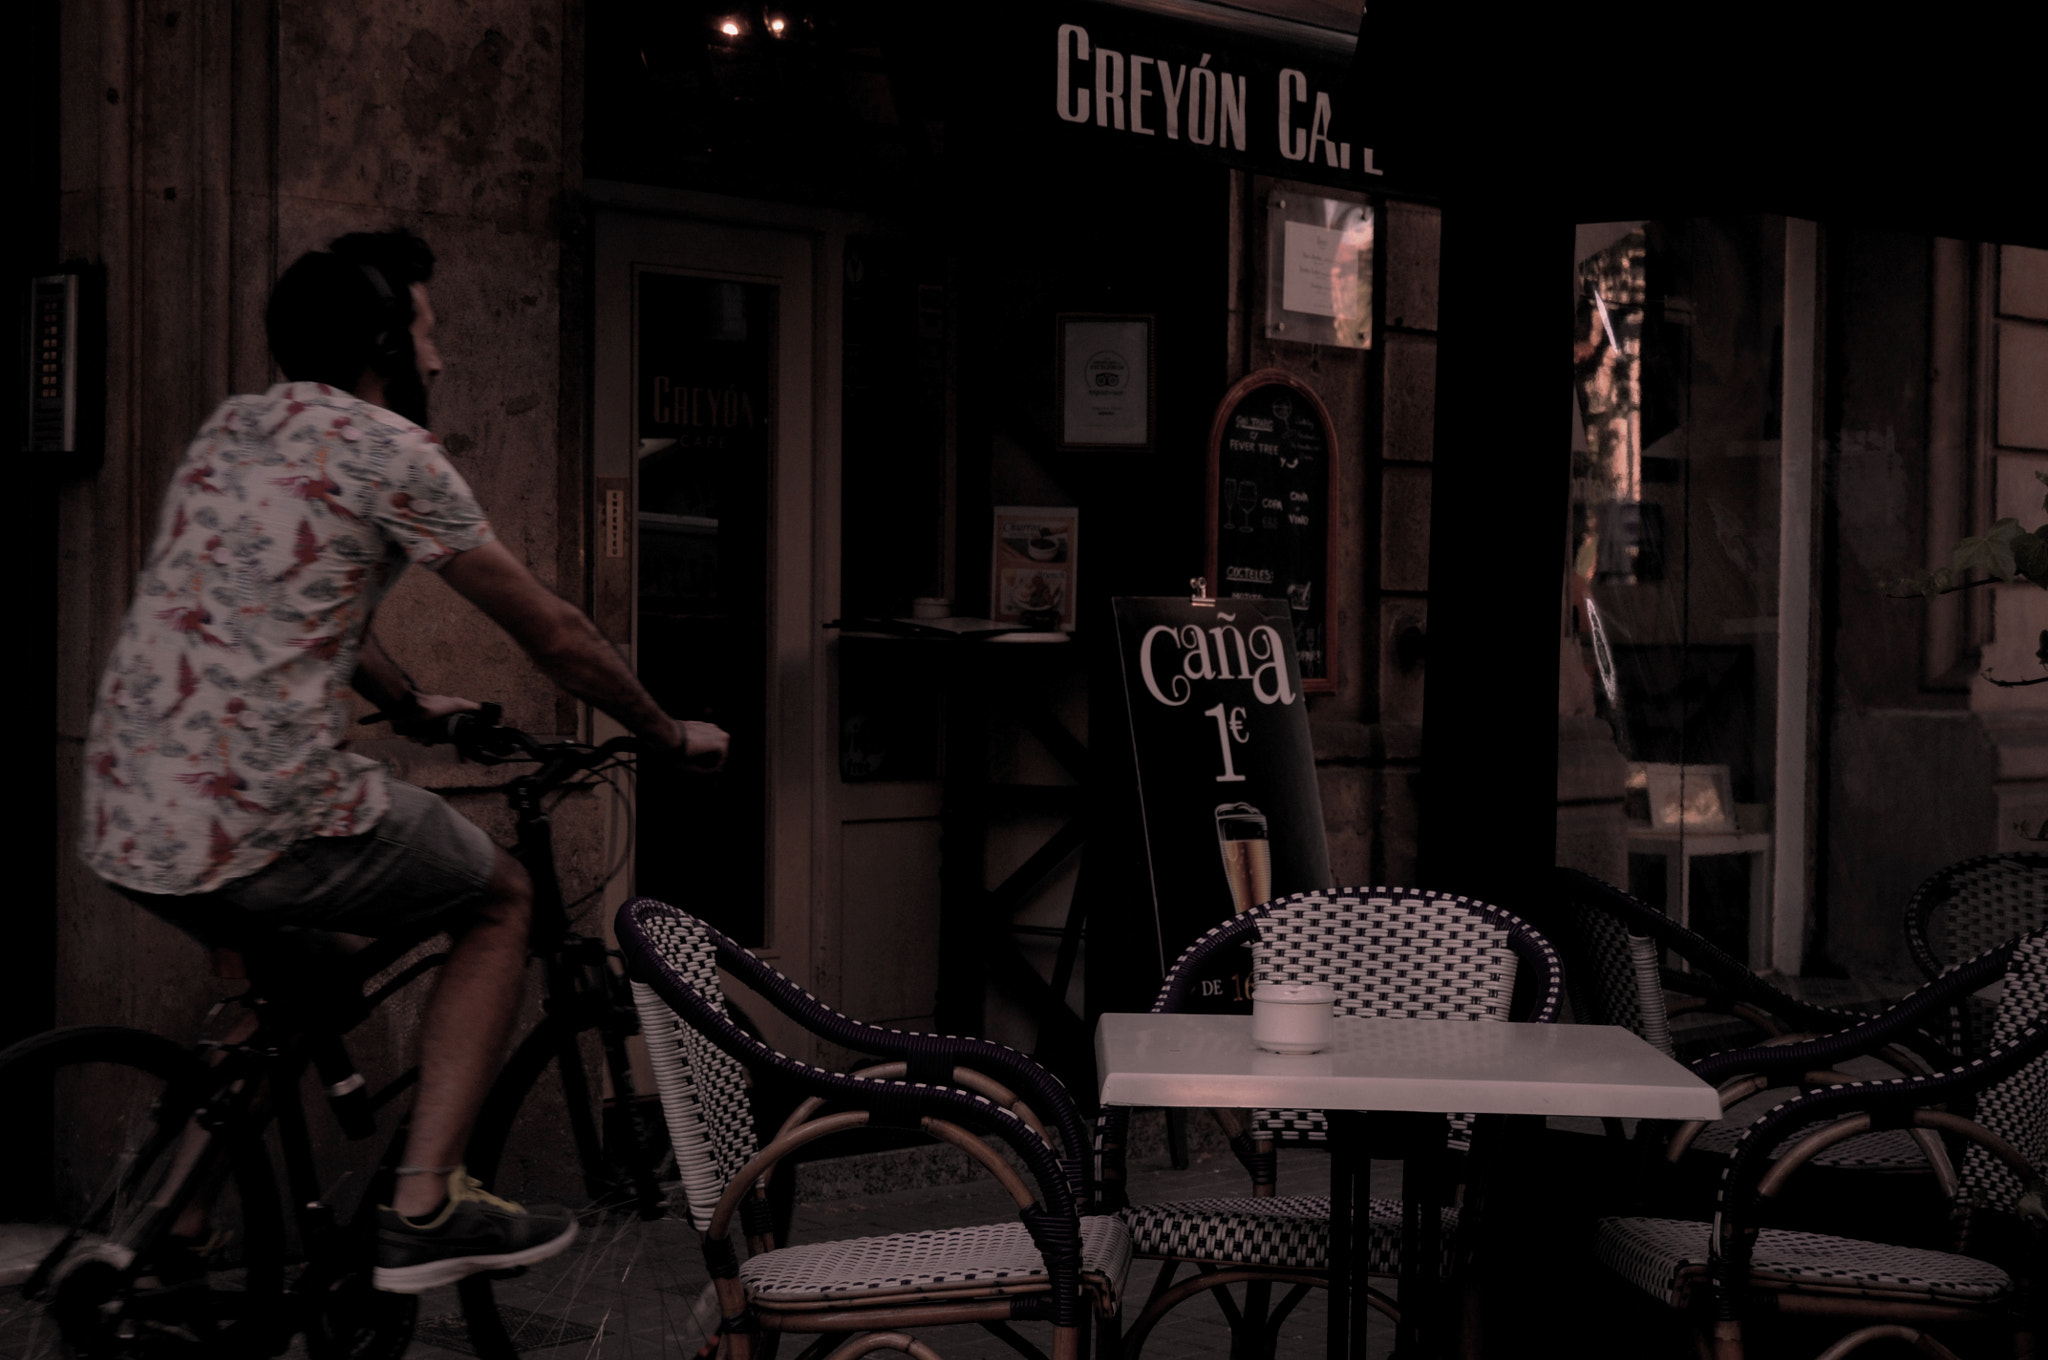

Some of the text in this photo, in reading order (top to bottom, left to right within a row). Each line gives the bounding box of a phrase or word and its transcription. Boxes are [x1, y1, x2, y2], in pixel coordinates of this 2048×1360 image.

[1056, 22, 1384, 176] CREYÓN CA
[653, 375, 756, 430] CREYÓN
[1229, 438, 1280, 456] FEVER TREE
[1261, 497, 1284, 512] COPA
[1287, 513, 1310, 527] VINO
[1203, 701, 1251, 784] 1€
[1201, 978, 1224, 998] DE
